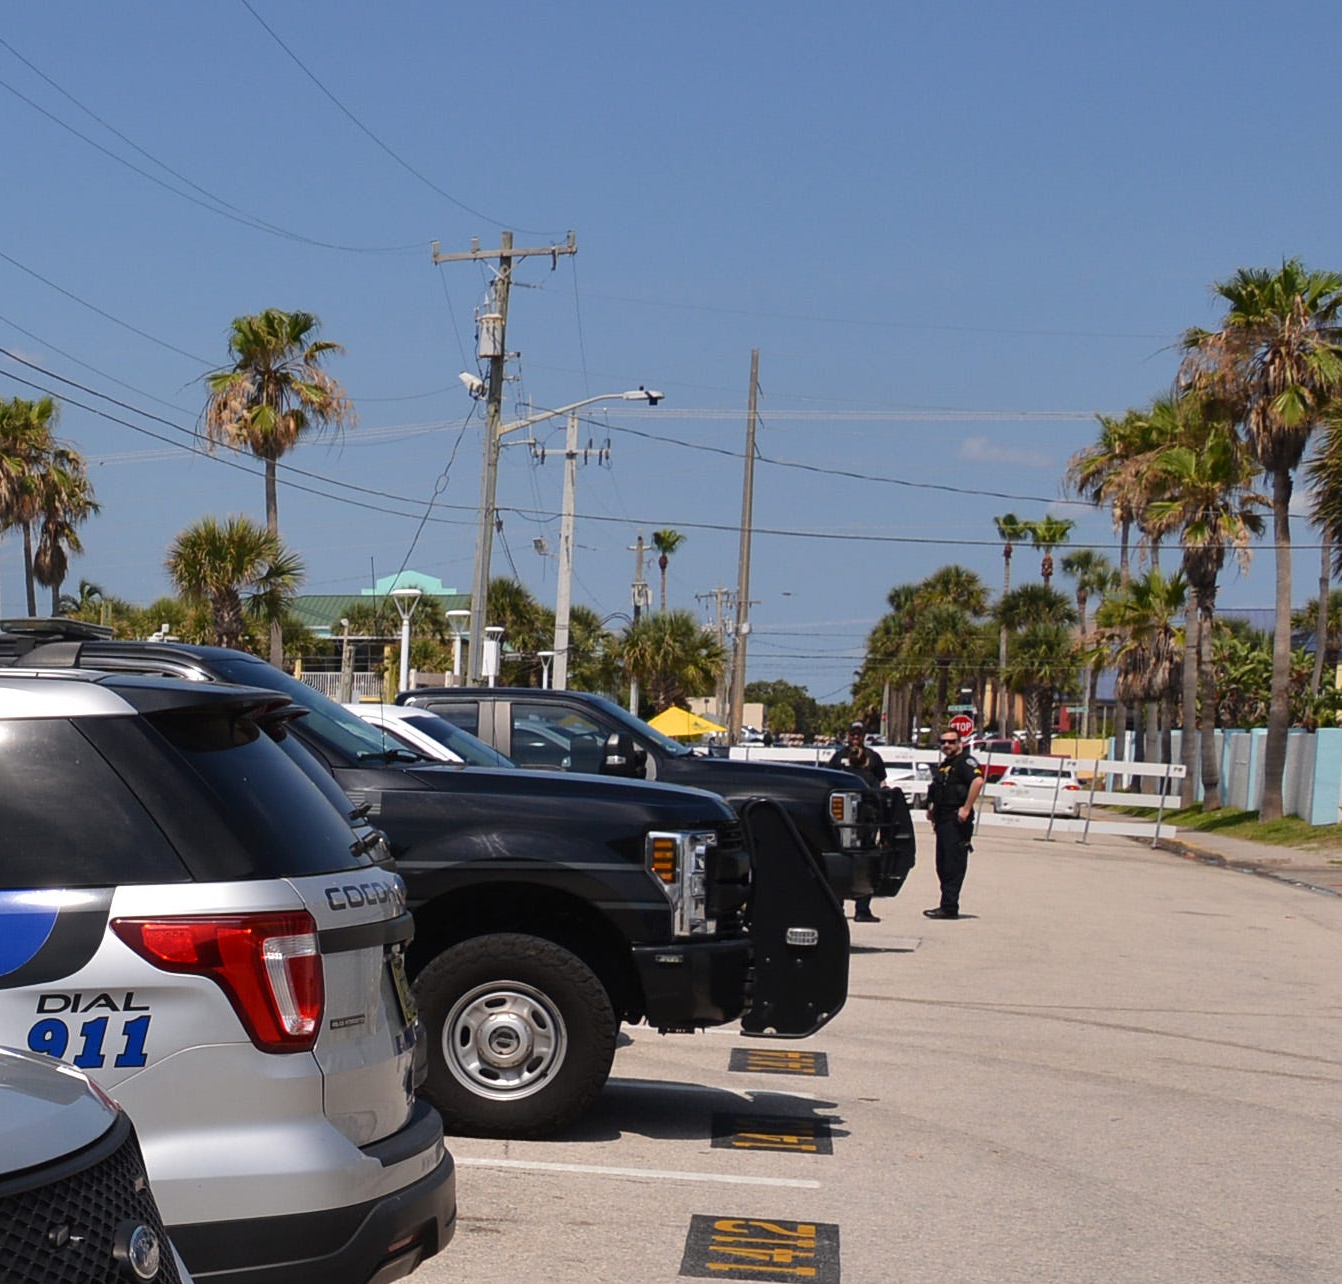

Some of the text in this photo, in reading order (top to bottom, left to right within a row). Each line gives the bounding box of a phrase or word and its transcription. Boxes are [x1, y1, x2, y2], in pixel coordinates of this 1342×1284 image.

[36, 991, 151, 1014] DIAL
[27, 1014, 152, 1069] 911
[706, 1219, 816, 1276] 1412
